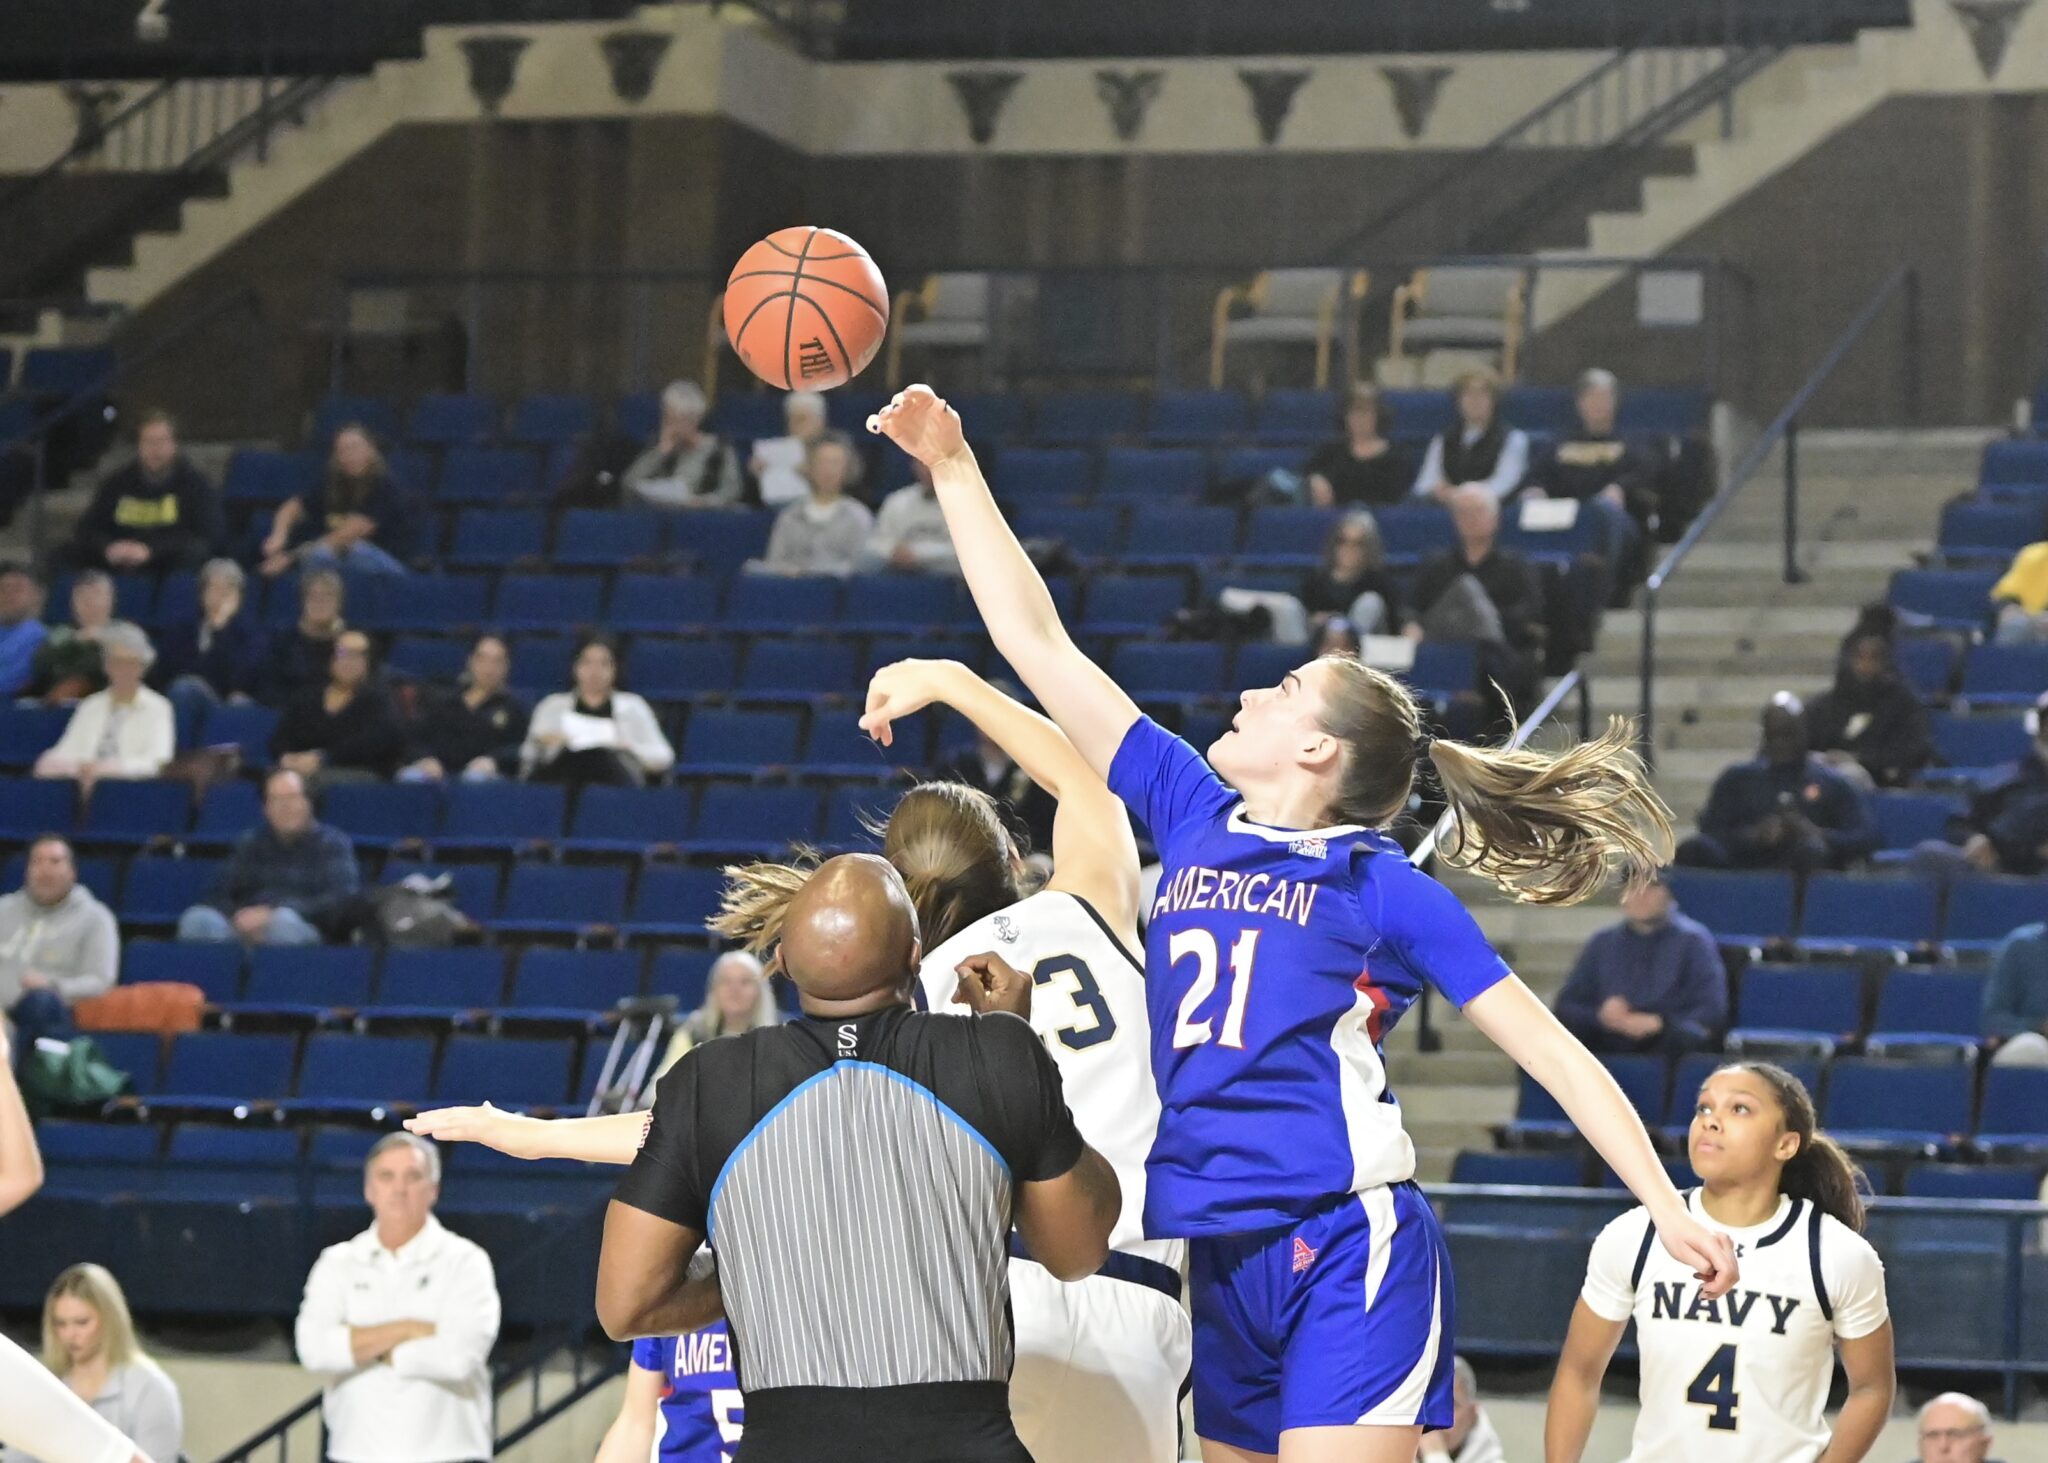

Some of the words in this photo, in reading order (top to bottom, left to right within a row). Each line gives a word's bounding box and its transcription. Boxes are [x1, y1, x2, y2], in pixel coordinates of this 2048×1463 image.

[800, 336, 835, 379] THE
[1152, 866, 1319, 927] AMERICAN
[1032, 952, 1117, 1051] 3
[1168, 928, 1261, 1050] 21
[838, 1049, 858, 1057] USA
[1652, 1281, 1801, 1335] NAVY
[1686, 1343, 1739, 1431] 4
